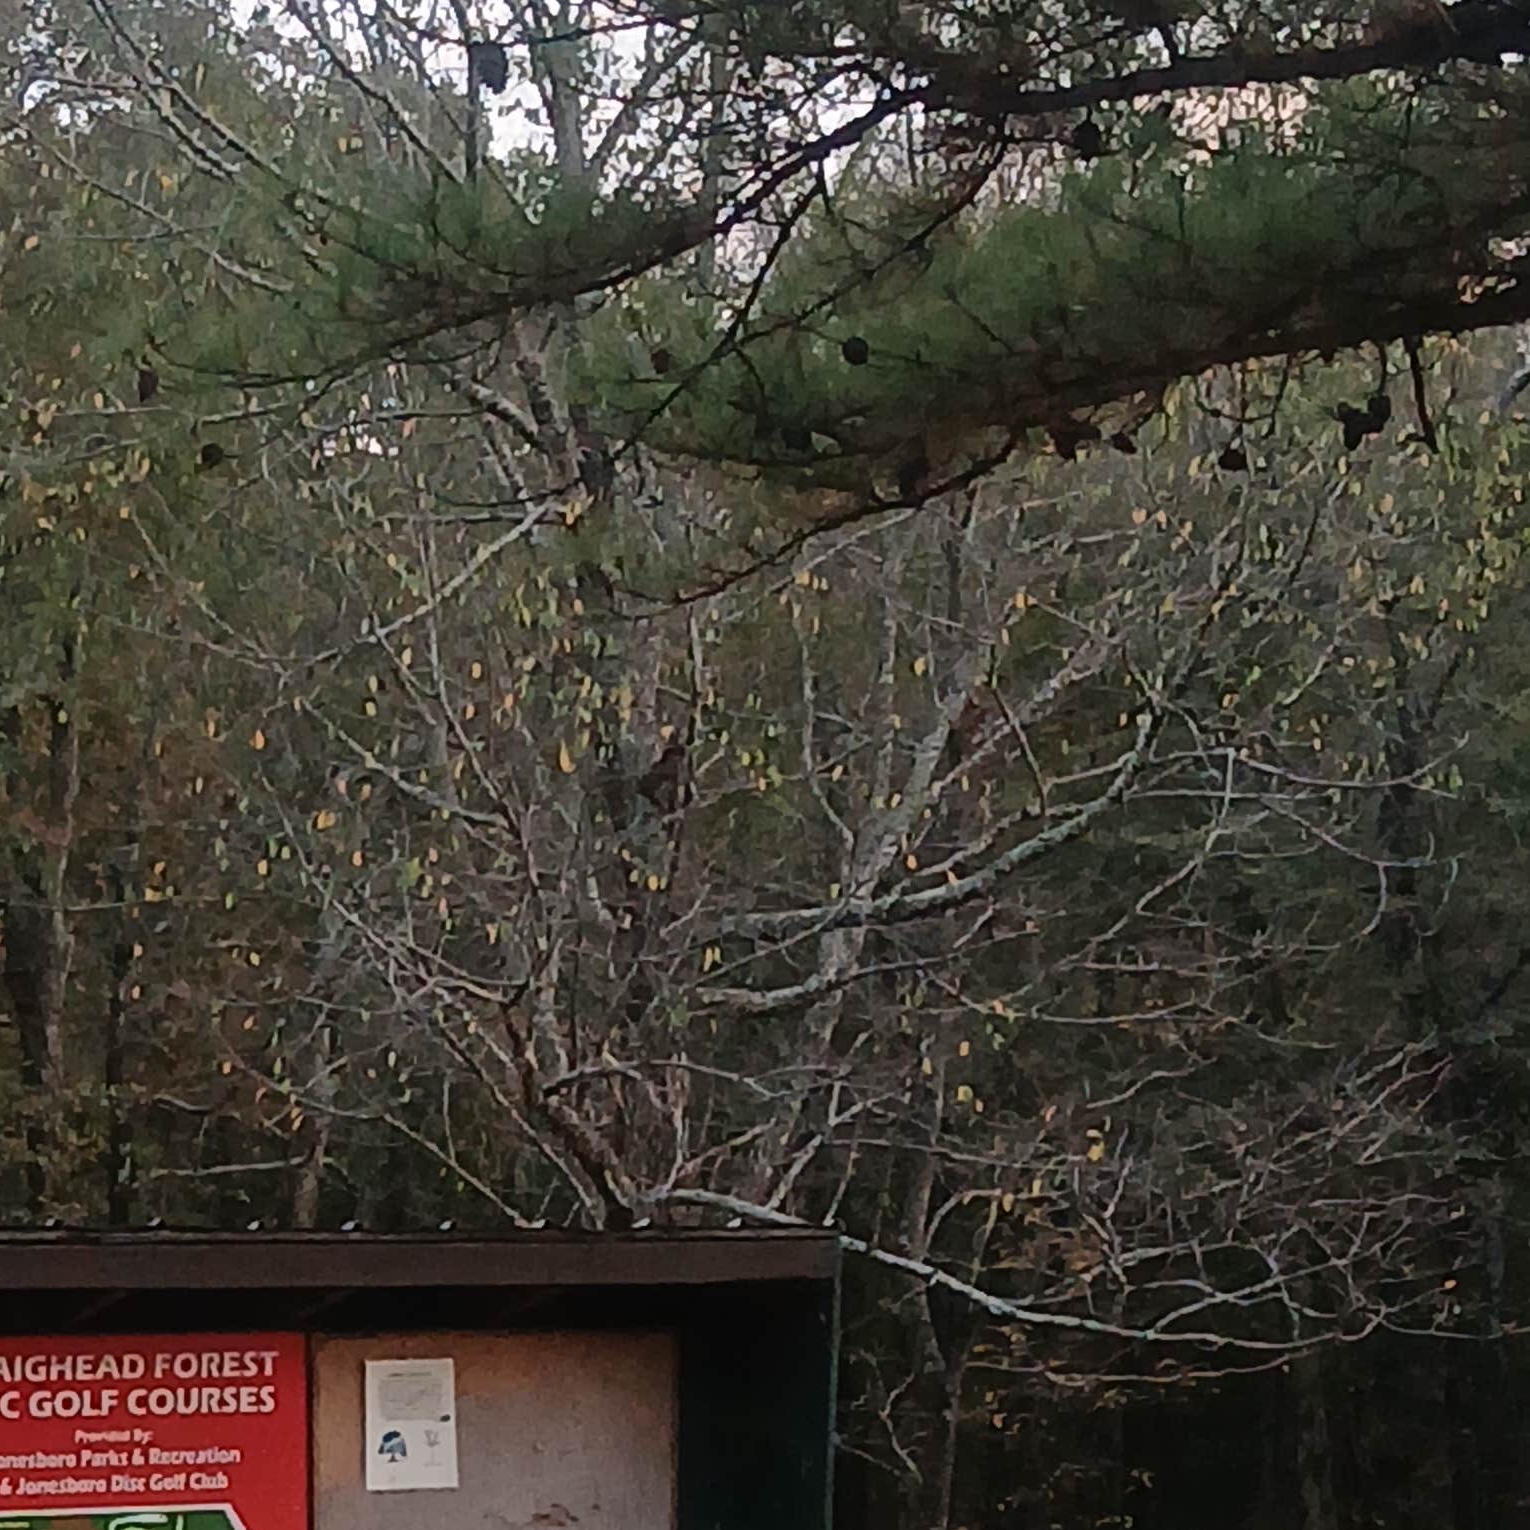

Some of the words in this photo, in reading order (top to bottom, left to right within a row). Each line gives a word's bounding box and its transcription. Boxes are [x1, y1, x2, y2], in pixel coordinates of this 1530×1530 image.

[154, 1351, 279, 1379] FOREST
[28, 1389, 119, 1418] GOLF
[127, 1386, 275, 1416] COURSES
[80, 1449, 128, 1467] Parks
[131, 1448, 145, 1466] &
[148, 1446, 241, 1465] Recreation
[0, 1477, 12, 1496] &
[15, 1476, 107, 1496] Jonesboro
[110, 1474, 146, 1493] Disc
[150, 1472, 187, 1492] Golf
[189, 1471, 229, 1489] Club
